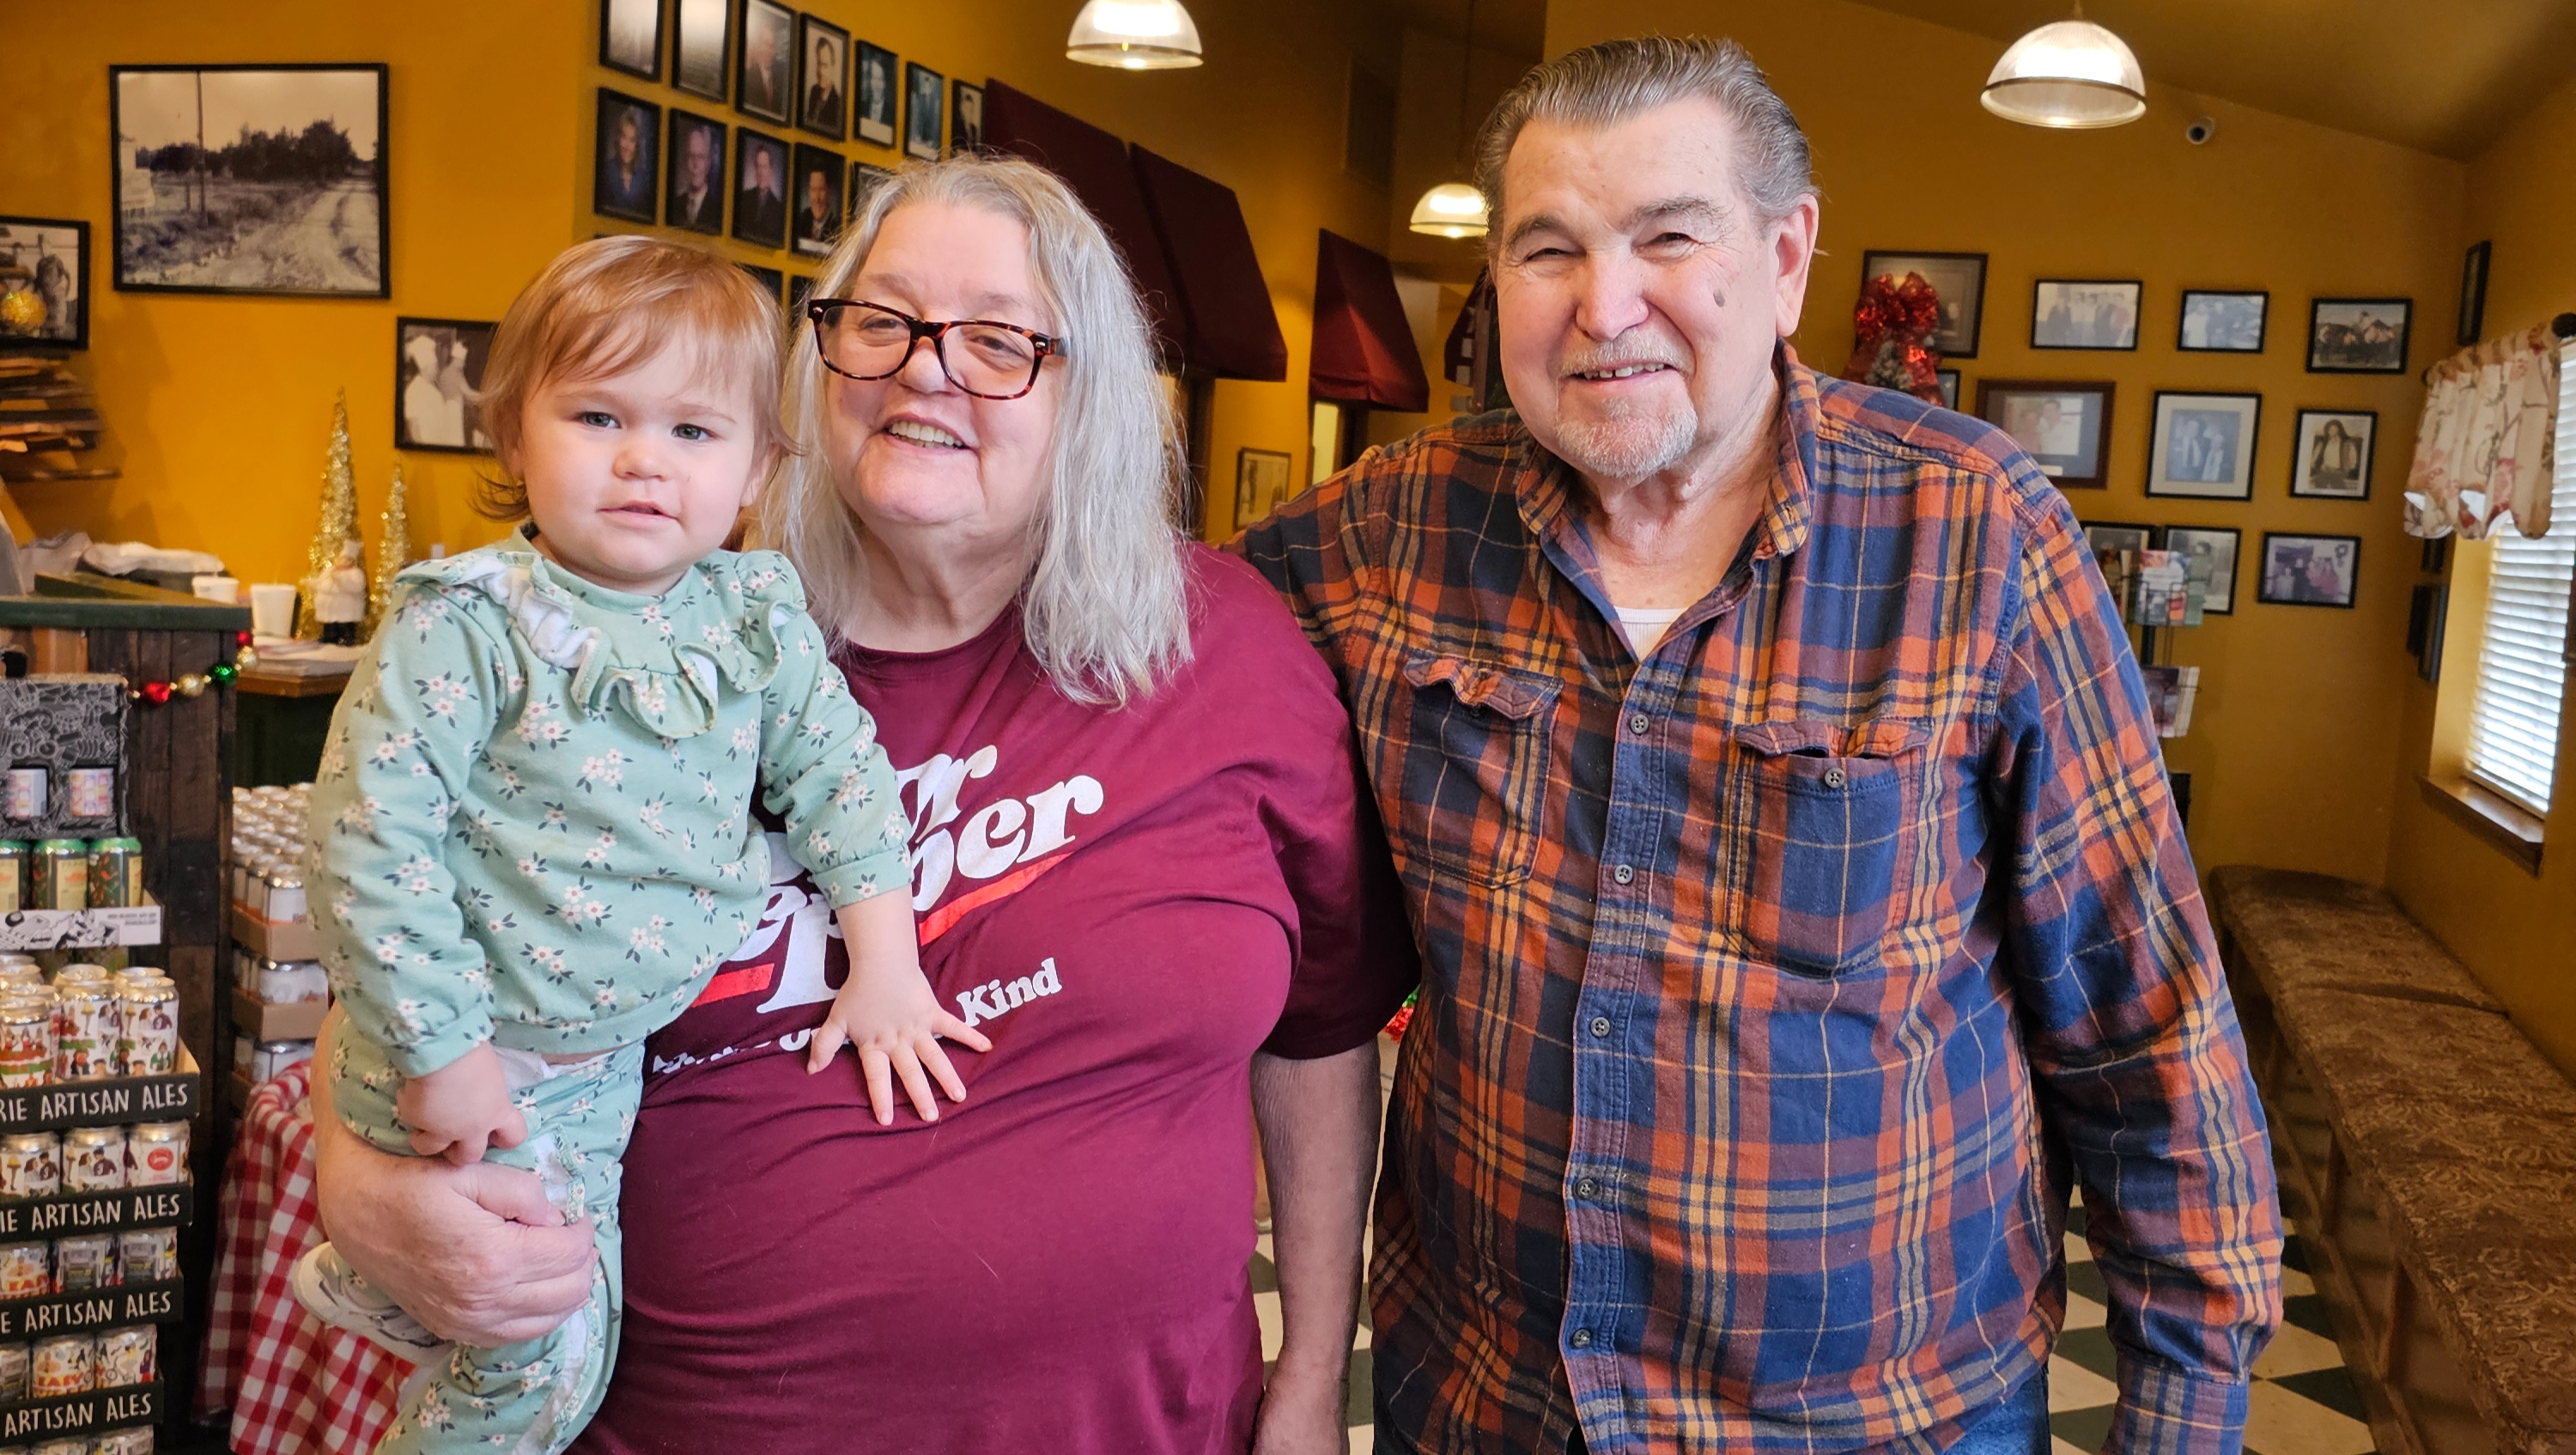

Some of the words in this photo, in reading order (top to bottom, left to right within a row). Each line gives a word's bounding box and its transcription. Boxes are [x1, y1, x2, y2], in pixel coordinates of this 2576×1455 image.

[956, 957, 1062, 1027] Kind
[40, 1088, 130, 1121] ARTISAN
[142, 1083, 188, 1111] ALES
[32, 1200, 122, 1232] ARTISAN
[134, 1194, 180, 1221] ALES
[25, 1299, 113, 1333] ARTISAN
[125, 1290, 171, 1319] ALES
[4, 1402, 94, 1438] ARTISAN
[106, 1392, 152, 1422] ALES
